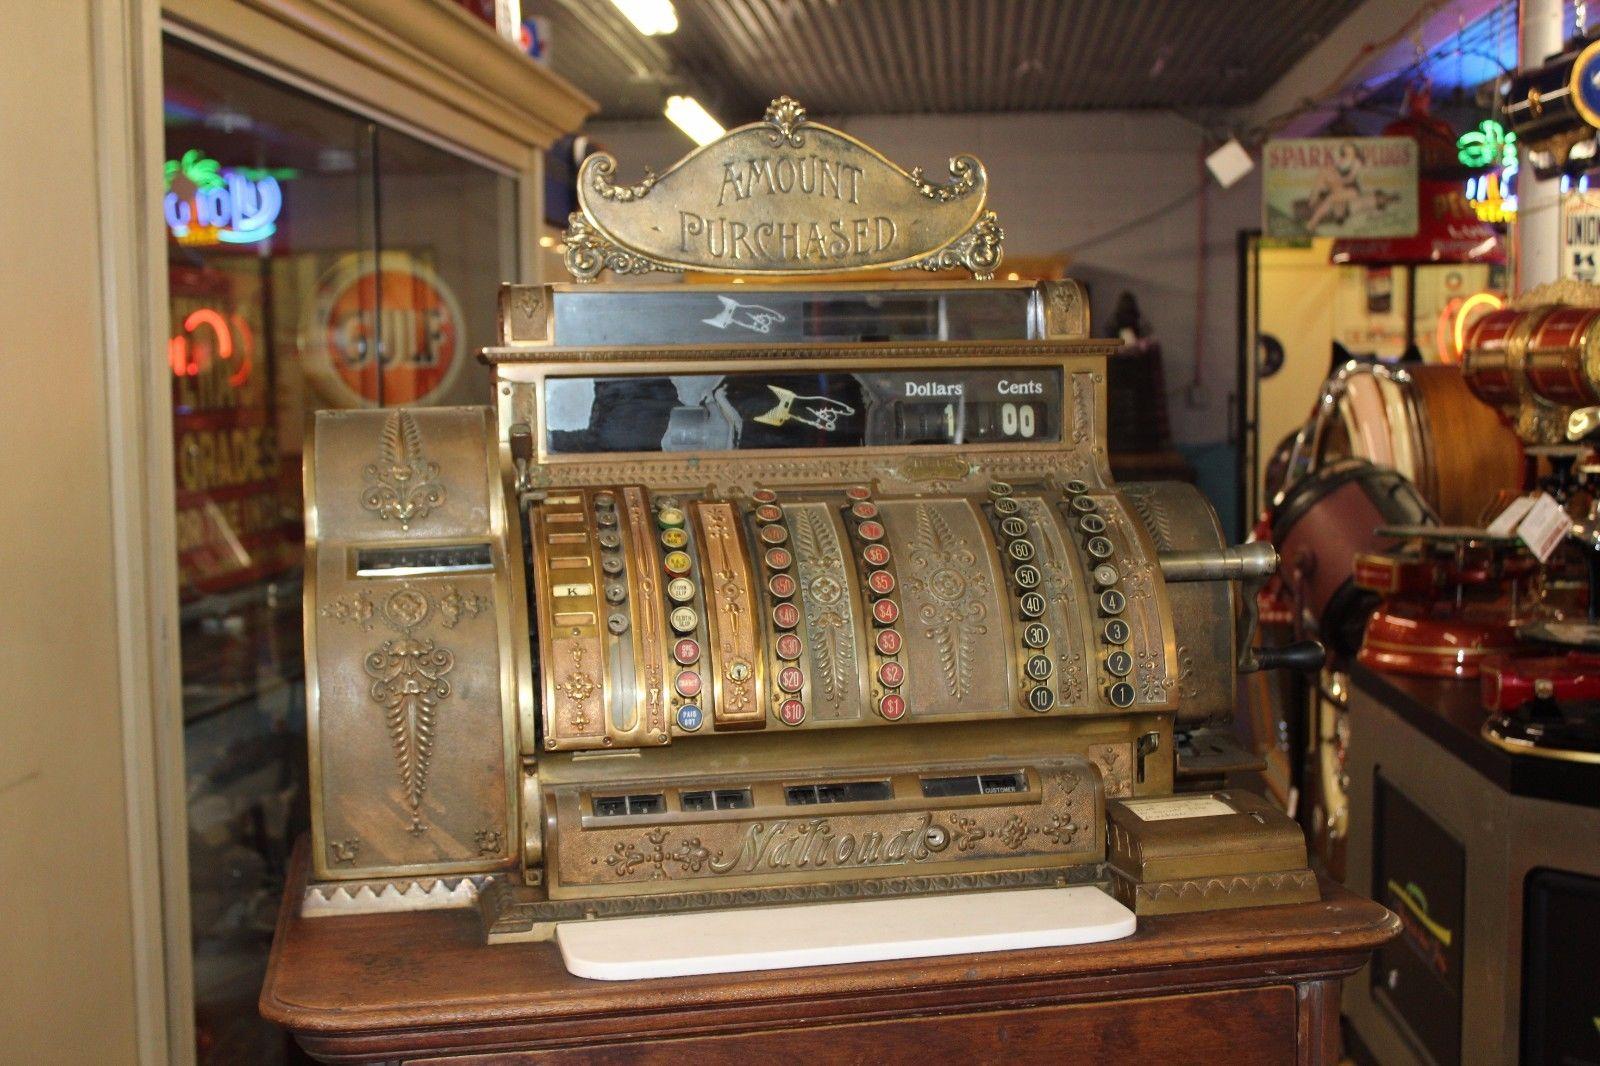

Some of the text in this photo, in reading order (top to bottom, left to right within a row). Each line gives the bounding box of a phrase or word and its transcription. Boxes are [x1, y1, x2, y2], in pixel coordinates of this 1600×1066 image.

[717, 154, 864, 206] AMOUNT
[678, 211, 897, 262] PURCHASED
[905, 379, 1043, 397] Dollars Cents
[944, 402, 1035, 438] 1 00
[1008, 522, 1022, 533] 70
[1015, 544, 1029, 557] 60
[875, 575, 888, 590] $5
[1021, 570, 1035, 584] 50
[568, 588, 577, 596] K
[1027, 597, 1040, 612] 40
[1109, 595, 1116, 610] 4
[779, 608, 795, 624] $40
[880, 604, 892, 619] $4
[1031, 628, 1044, 643] 30
[1113, 624, 1121, 639] 3
[782, 639, 798, 655] $30
[882, 634, 895, 650] $3
[1034, 659, 1047, 675] 20
[1117, 655, 1124, 671] 2
[783, 671, 799, 687] $20
[886, 666, 899, 681] $2
[1037, 690, 1047, 706] 10
[784, 705, 801, 720] $10
[887, 699, 899, 714] $1
[683, 711, 697, 719] PAID
[985, 786, 1015, 794] CUSTOMER
[709, 812, 931, 875] National
